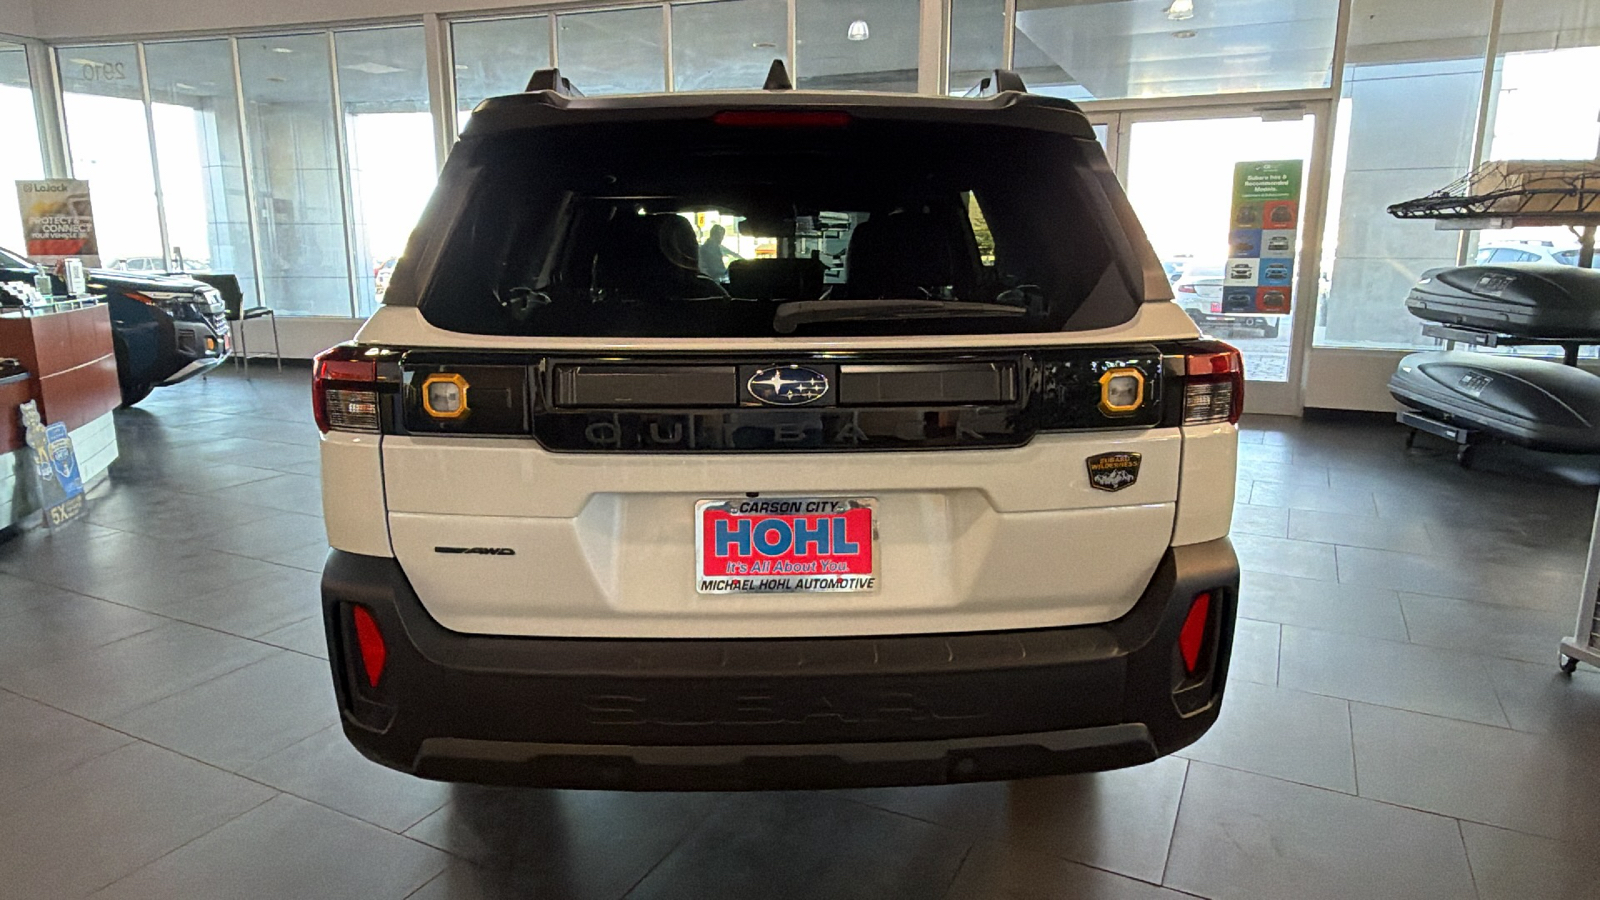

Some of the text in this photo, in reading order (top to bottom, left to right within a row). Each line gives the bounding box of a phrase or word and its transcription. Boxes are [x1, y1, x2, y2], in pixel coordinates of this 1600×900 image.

[34, 183, 68, 193] LoJack
[28, 216, 72, 225] PROTECT
[42, 223, 92, 233] CONNECT
[584, 421, 986, 445] OUTBAK
[739, 501, 839, 514] CARSON CITY
[715, 517, 860, 557] HOHL
[726, 559, 850, 573] It's All About You.
[700, 577, 876, 591] MICHAEL HOHL AUTOMOTIVE
